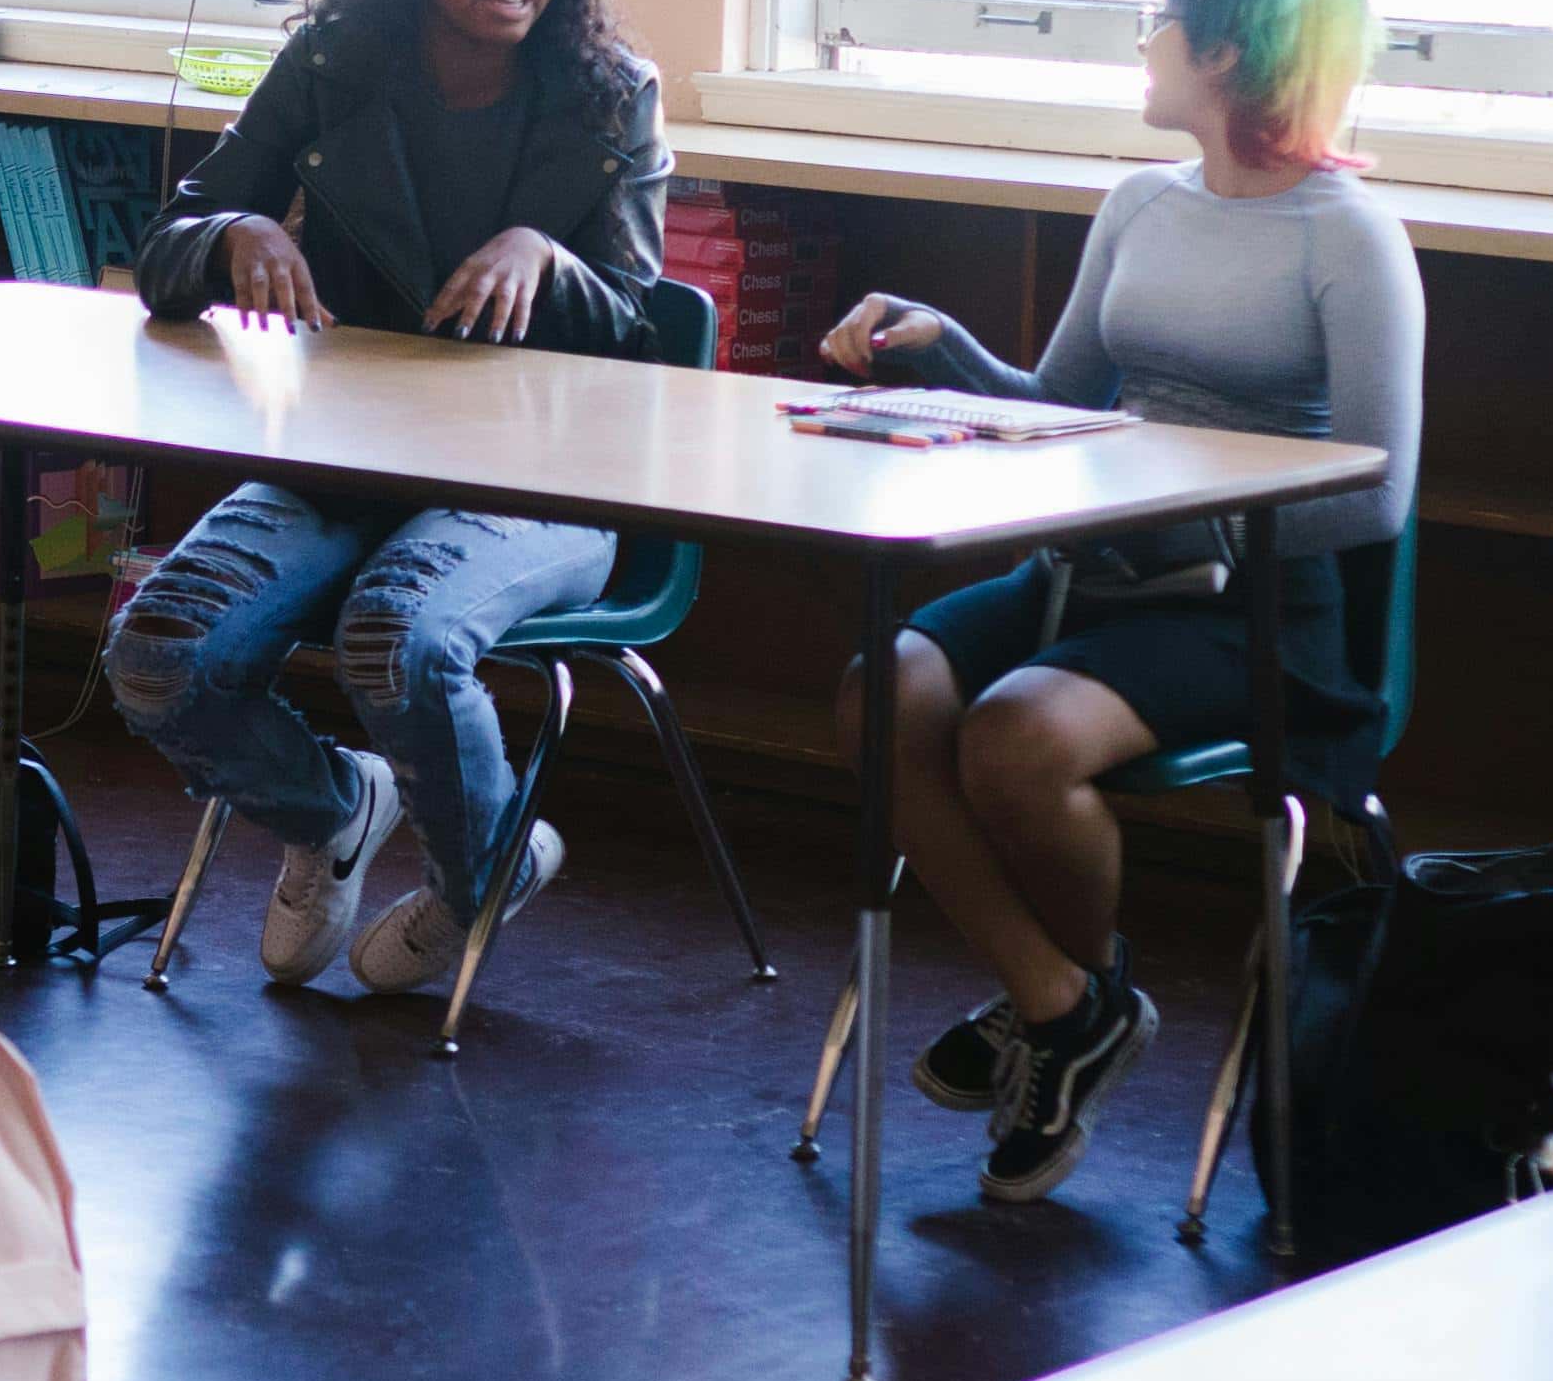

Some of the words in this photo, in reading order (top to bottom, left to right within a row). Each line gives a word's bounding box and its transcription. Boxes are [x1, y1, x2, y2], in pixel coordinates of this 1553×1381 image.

[741, 208, 779, 225] Chess
[749, 241, 788, 258] Chess
[742, 274, 781, 291] Chess
[739, 308, 779, 325] Chess
[732, 343, 772, 359] Chess
